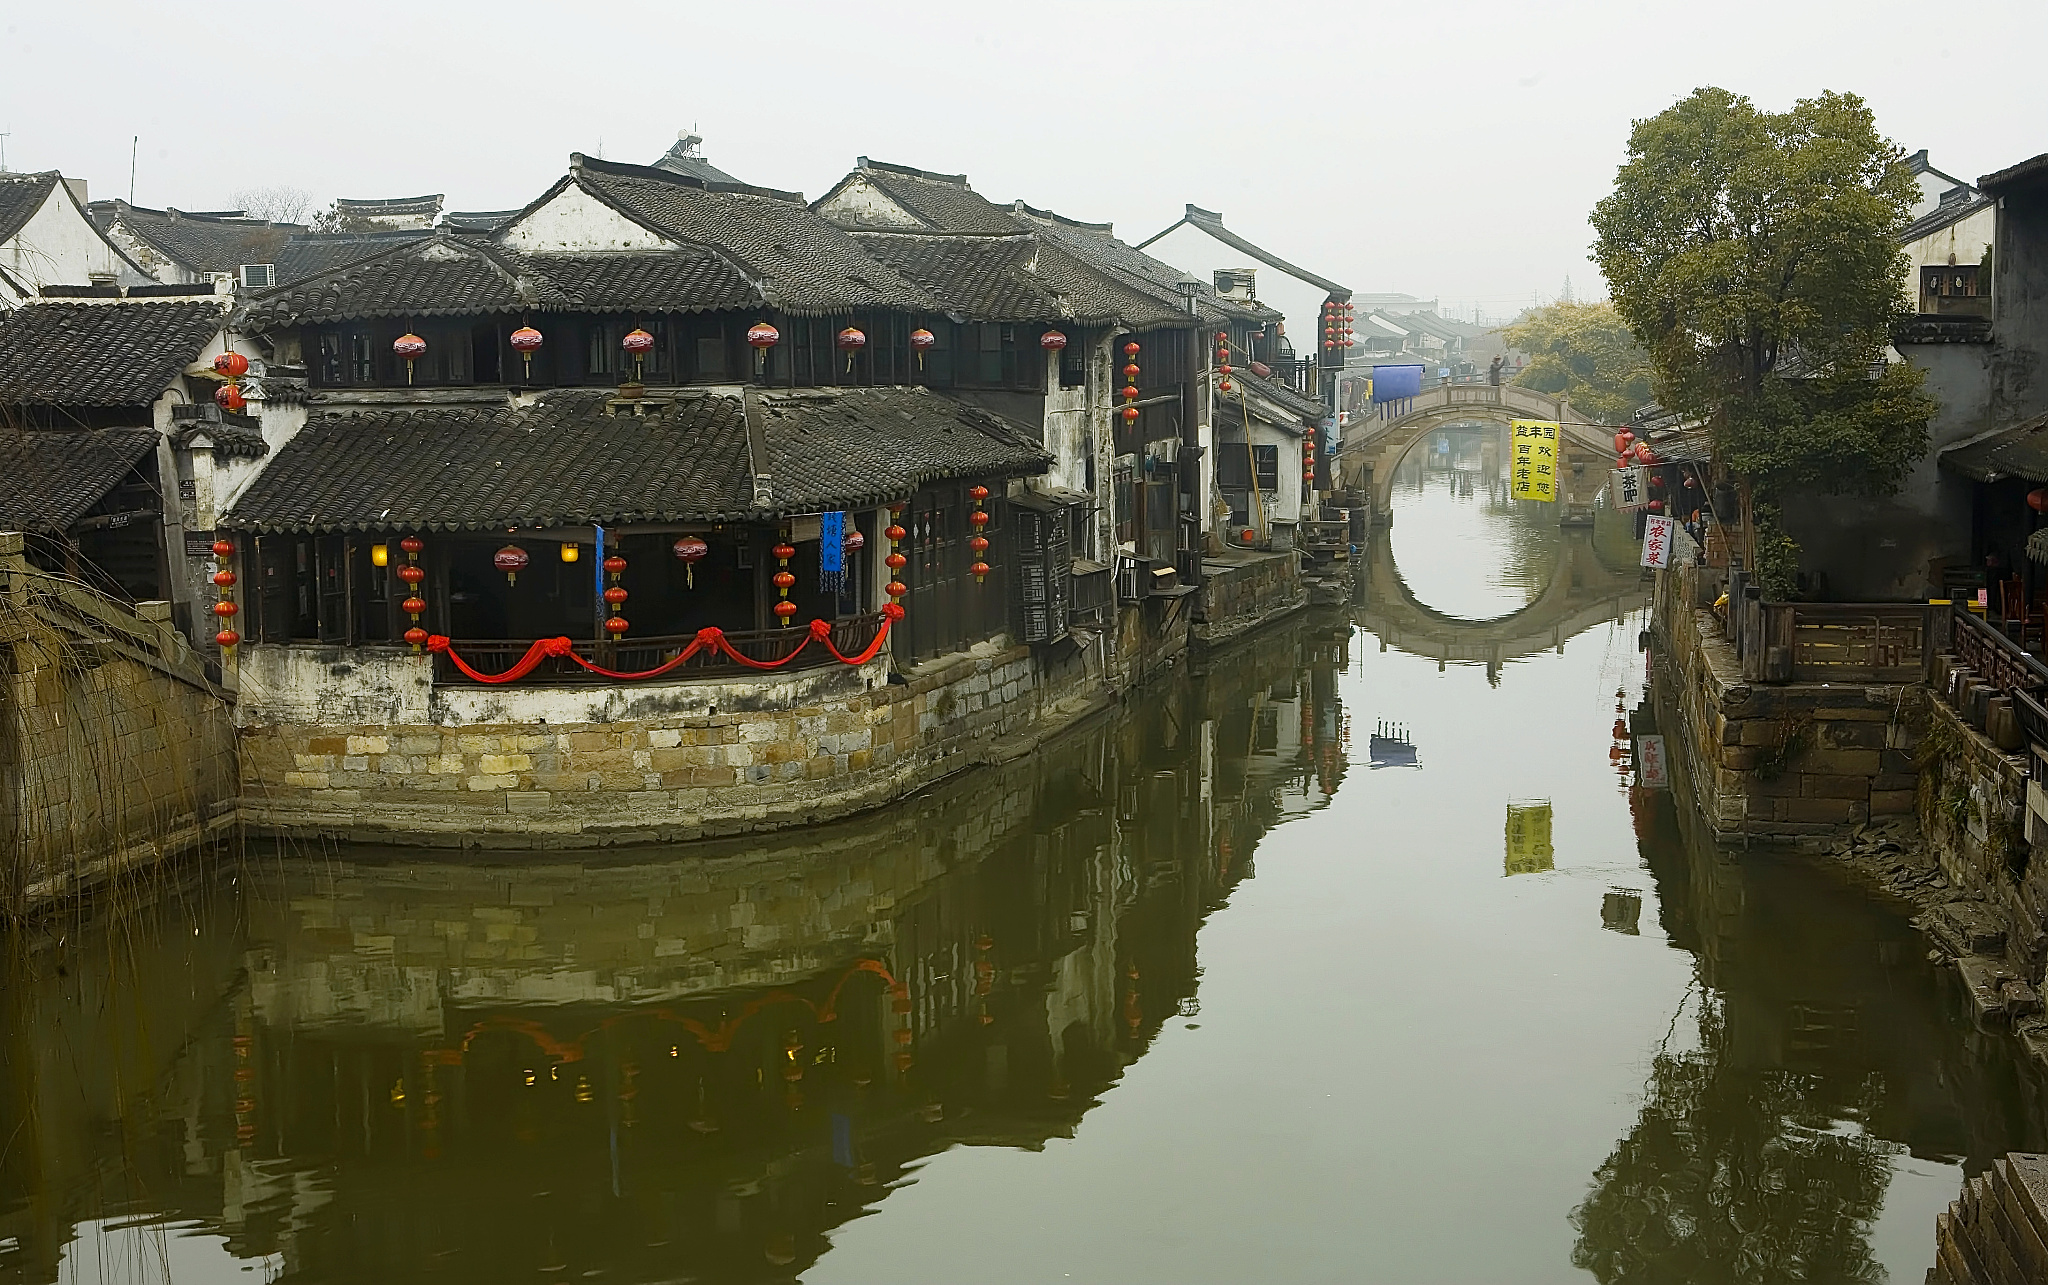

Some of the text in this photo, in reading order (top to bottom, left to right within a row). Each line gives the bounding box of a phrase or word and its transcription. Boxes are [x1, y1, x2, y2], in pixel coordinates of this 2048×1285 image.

[1515, 425, 1556, 440] 益丰园
[1516, 444, 1532, 492] 百年老店
[1536, 446, 1552, 495] 欢迎您
[1622, 474, 1638, 503] 茶吧
[1646, 525, 1667, 566] 农家菜
